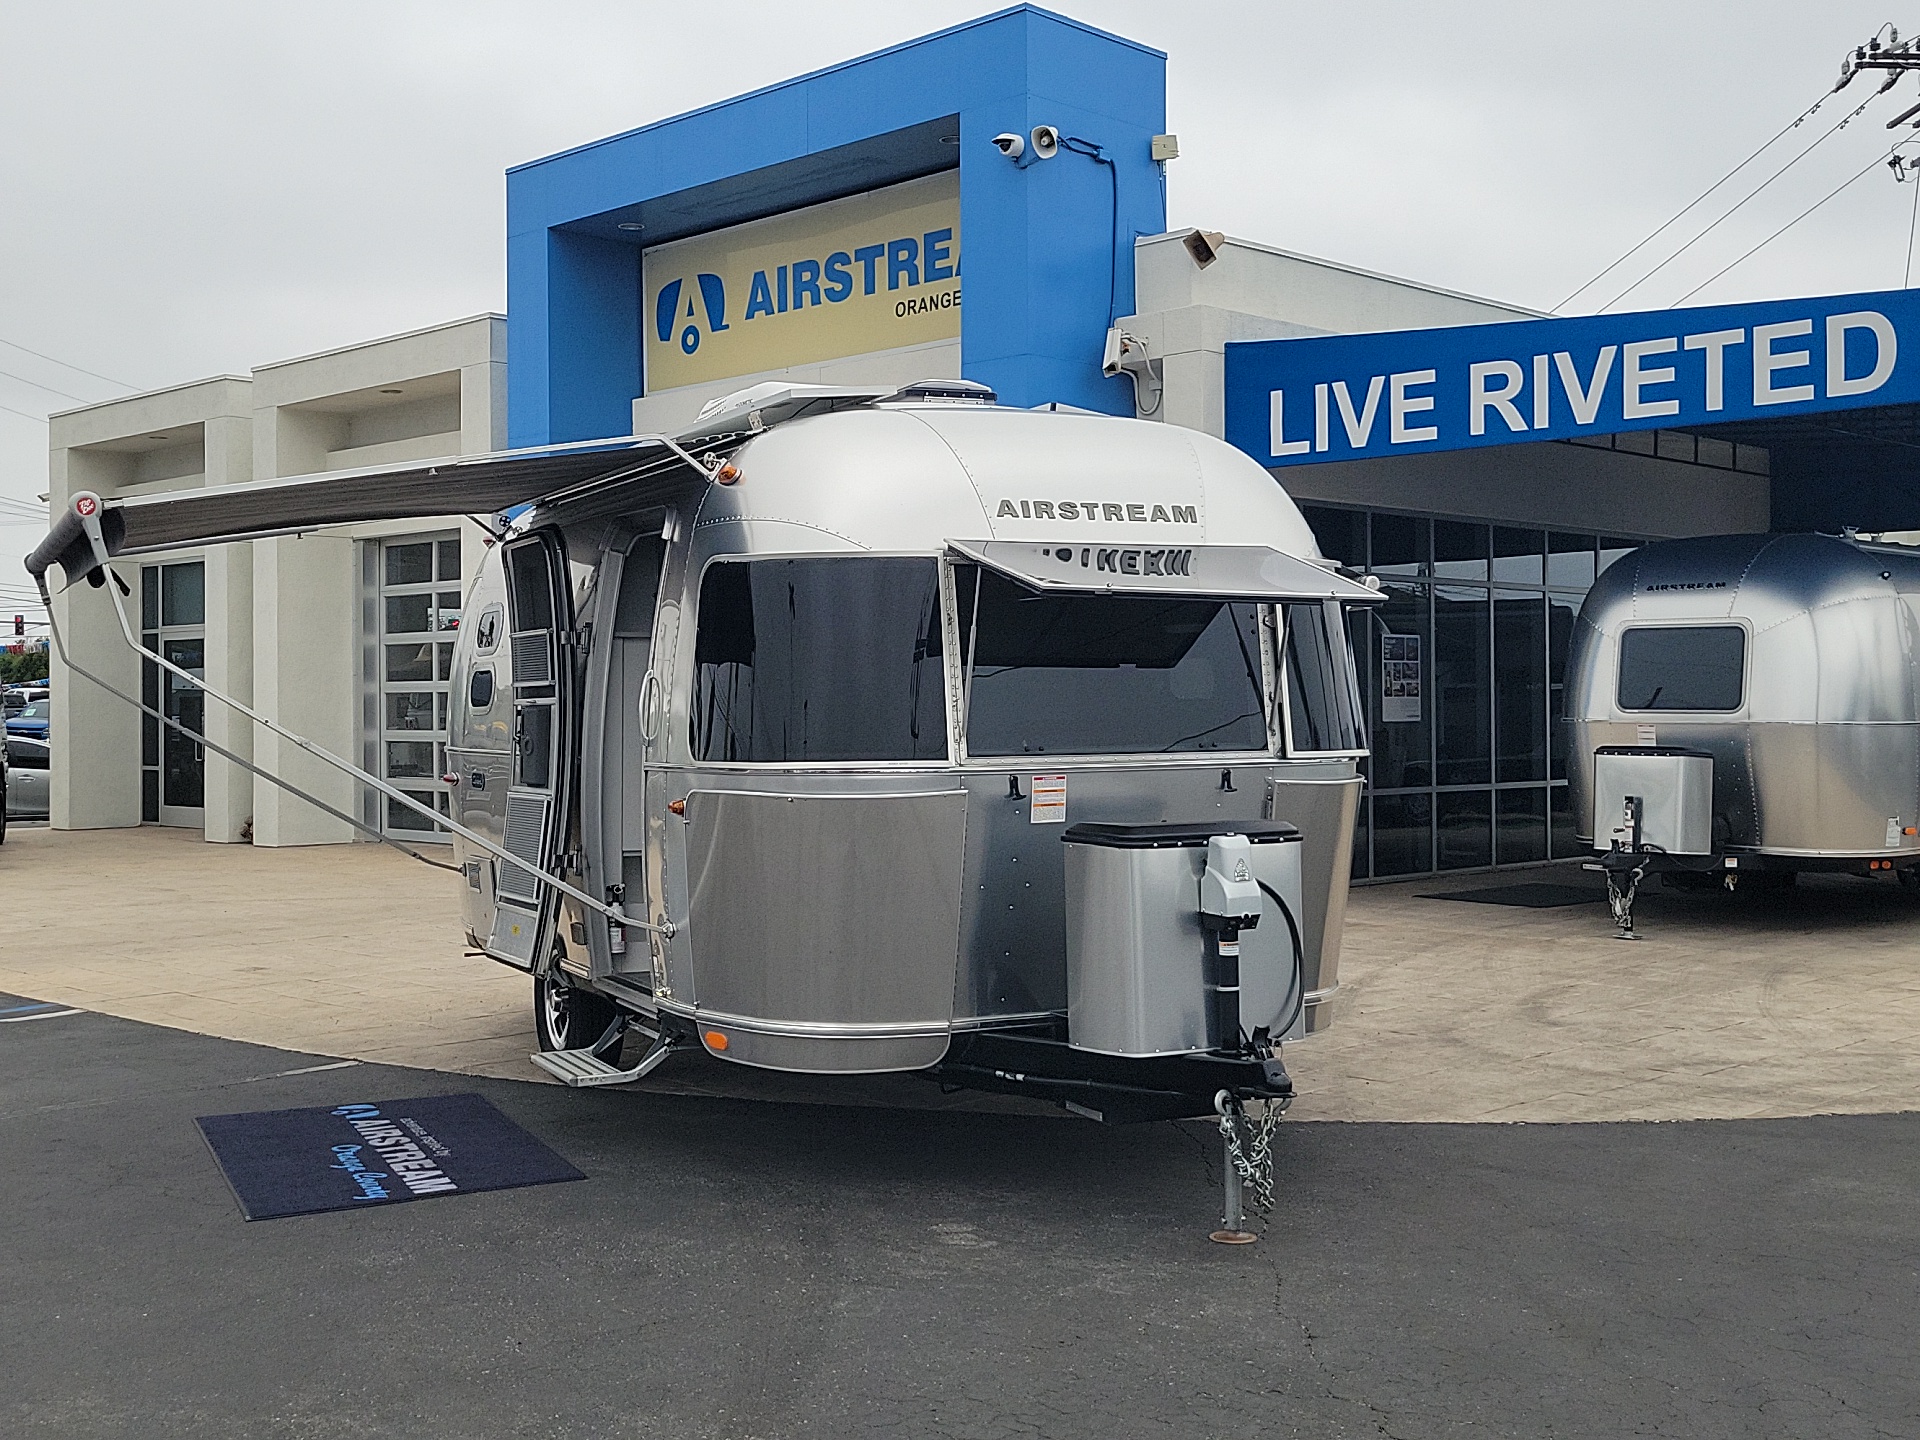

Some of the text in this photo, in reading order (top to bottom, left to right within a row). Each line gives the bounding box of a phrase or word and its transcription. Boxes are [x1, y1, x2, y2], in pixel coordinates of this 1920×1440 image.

[745, 227, 961, 320] AIRSTRE
[895, 290, 961, 317] ORANGE
[1269, 311, 1898, 457] LIVE RIVETED
[997, 499, 1198, 524] AIRSTREAM
[1646, 582, 1726, 592] AIRSTREAM
[330, 1144, 391, 1199] Orange County
[349, 1119, 459, 1194] AIRSTREAM
